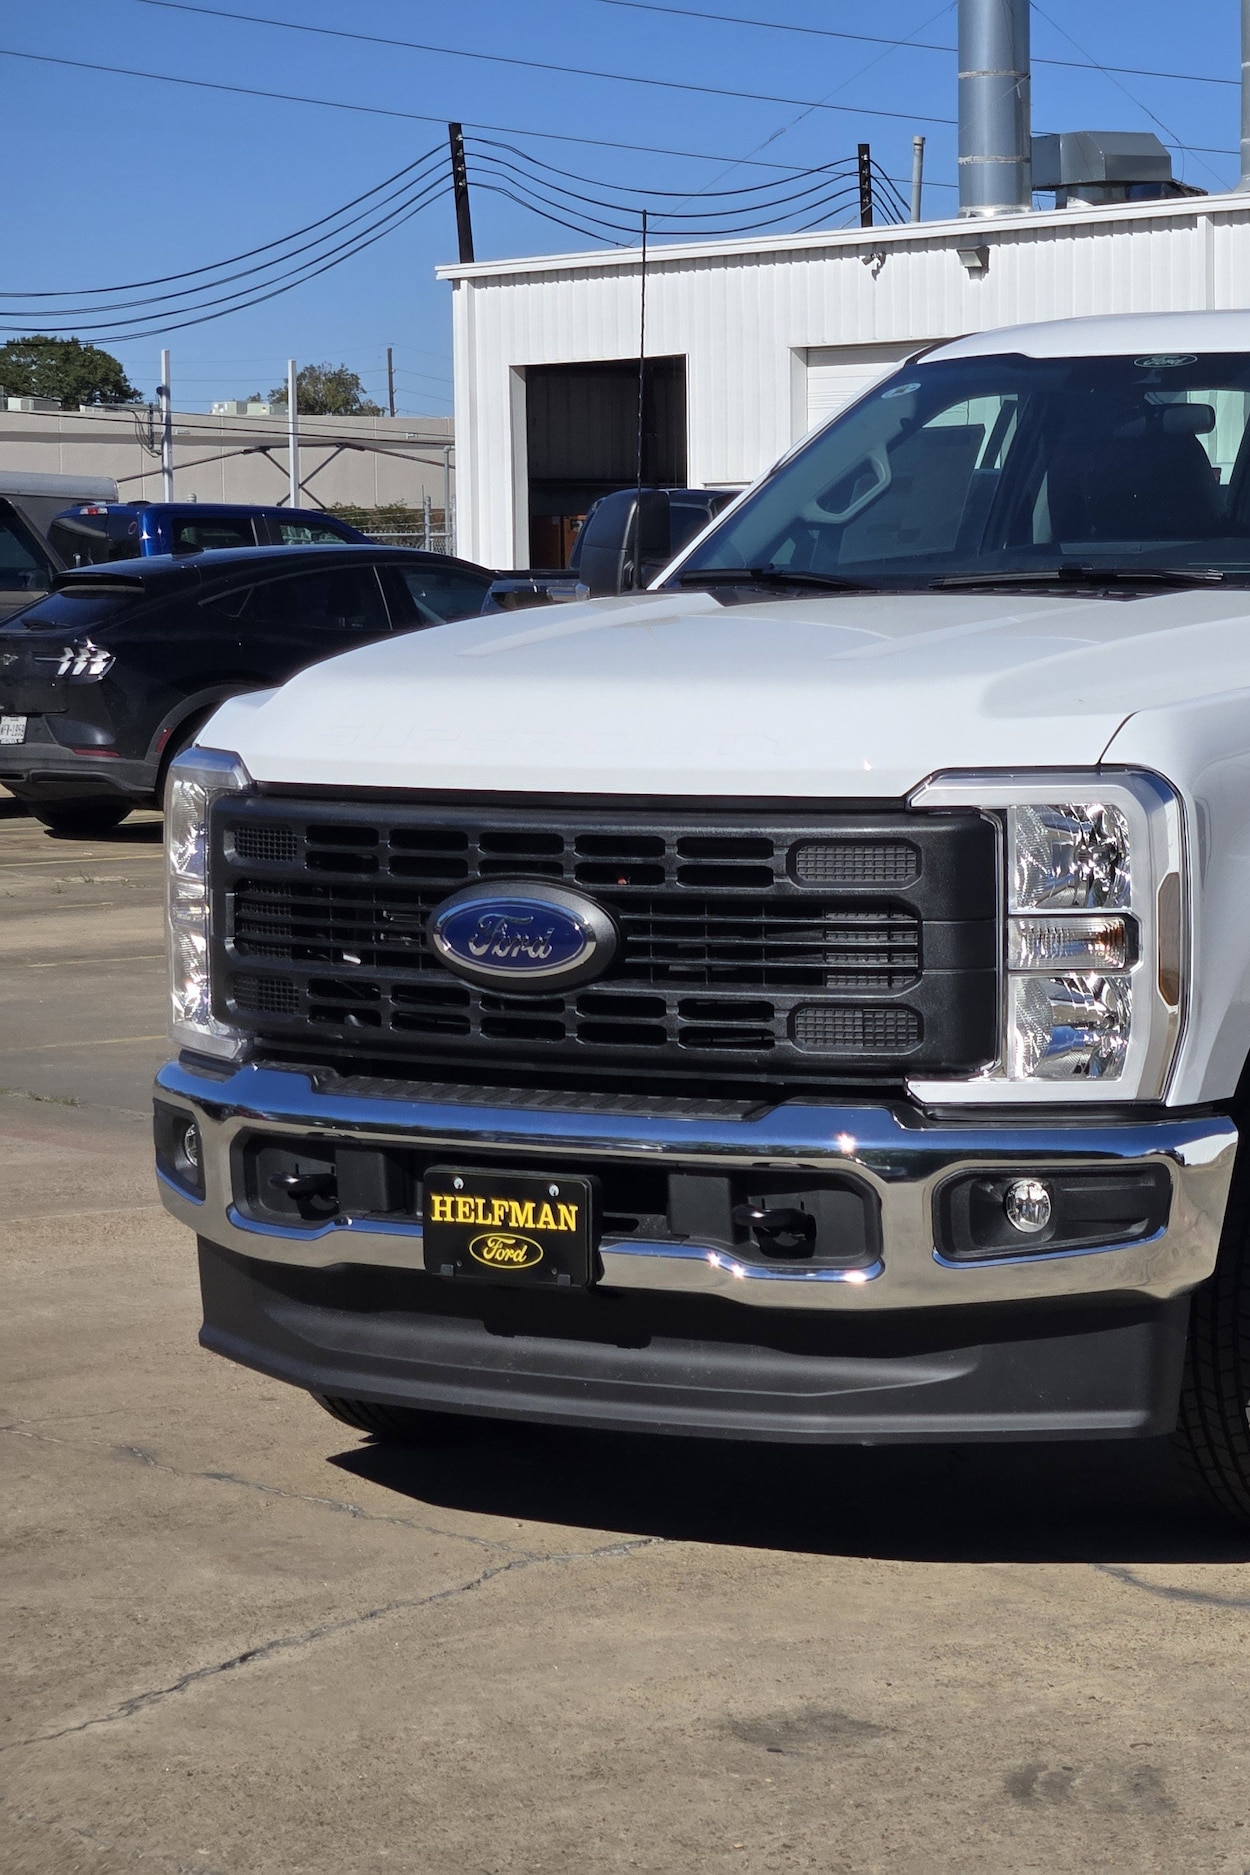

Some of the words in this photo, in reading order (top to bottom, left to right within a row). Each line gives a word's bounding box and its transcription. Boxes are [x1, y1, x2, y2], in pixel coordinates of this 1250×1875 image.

[468, 912, 555, 959] Ford
[431, 1195, 578, 1232] HELFMAN
[483, 1236, 528, 1263] Ford
